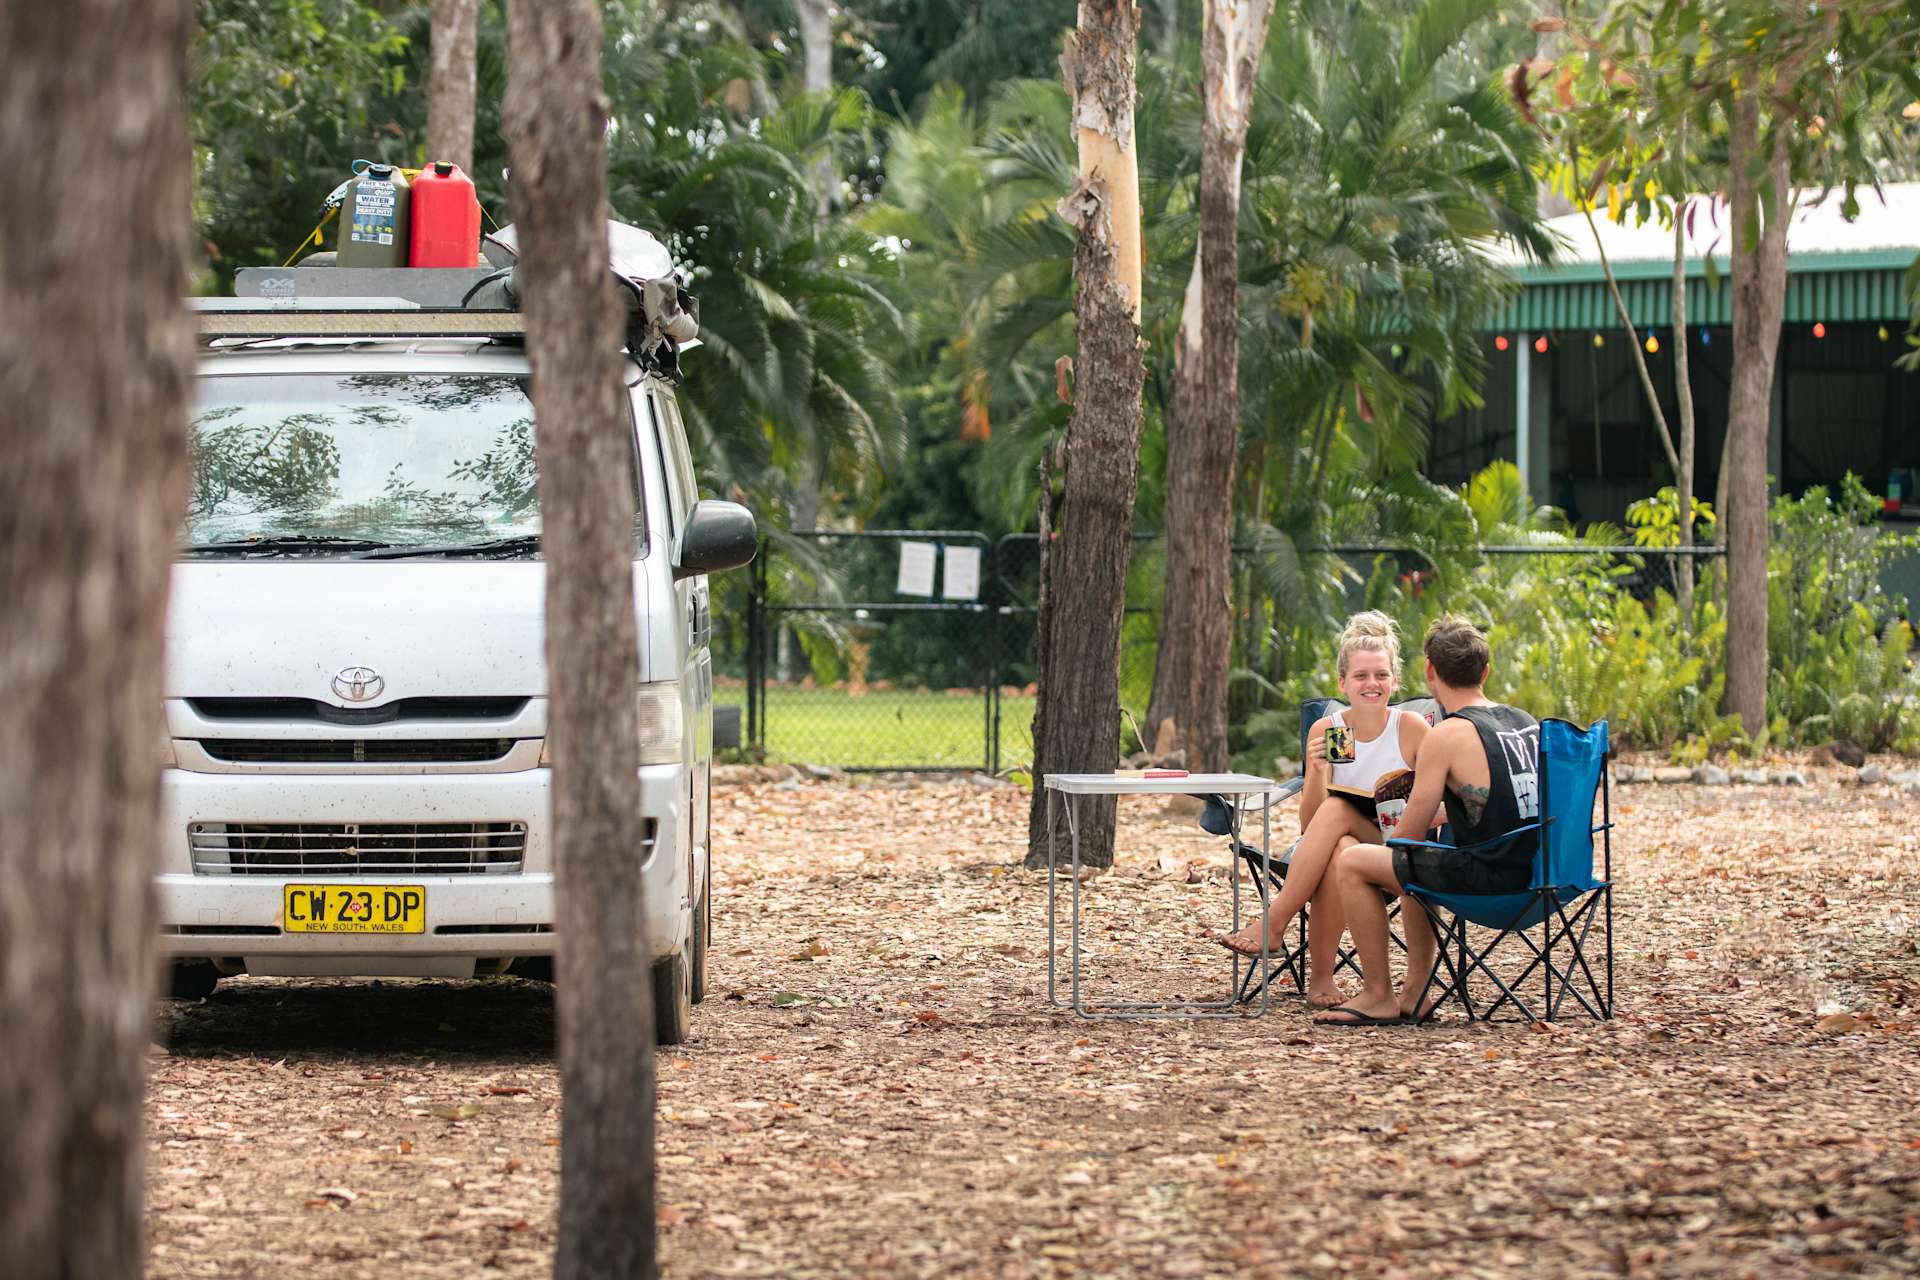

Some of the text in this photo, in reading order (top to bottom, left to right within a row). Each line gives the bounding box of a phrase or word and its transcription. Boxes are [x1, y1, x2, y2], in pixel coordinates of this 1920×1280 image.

[361, 196, 389, 204] WATER
[306, 923, 404, 932] NEW SOUTH WALES
